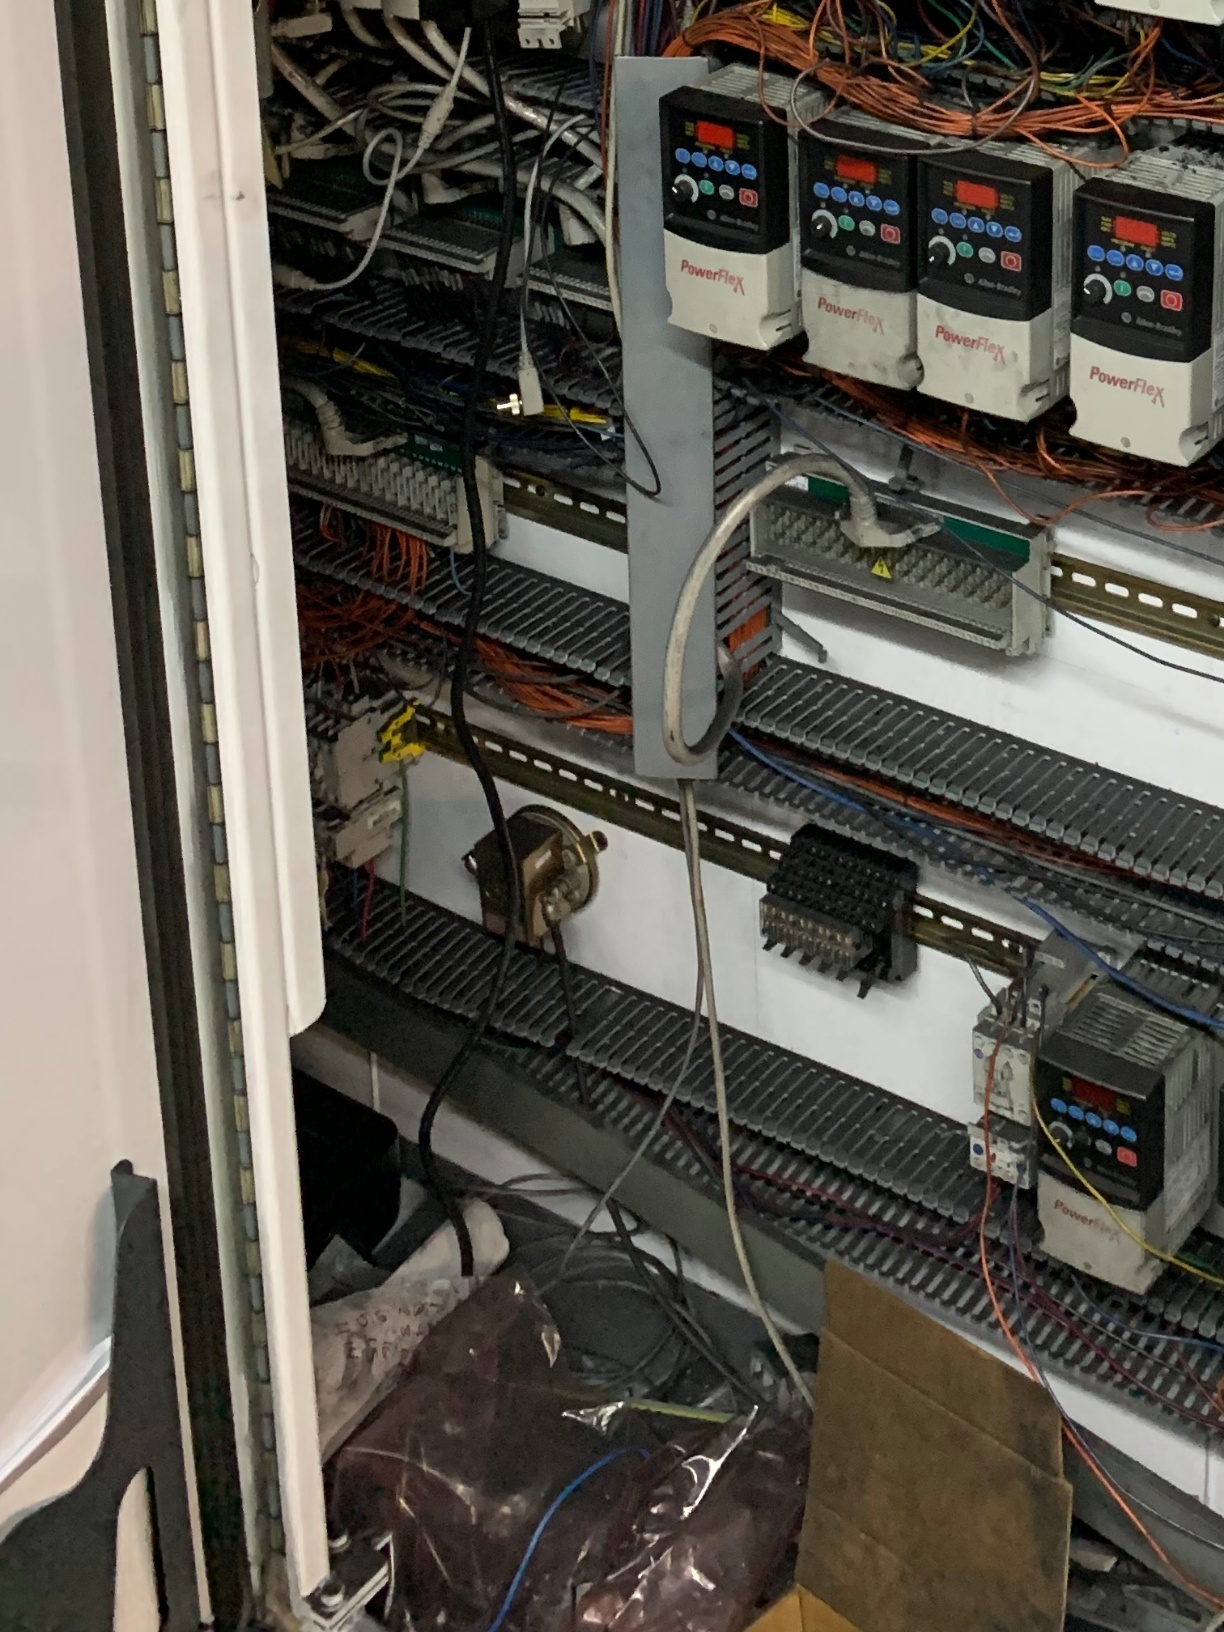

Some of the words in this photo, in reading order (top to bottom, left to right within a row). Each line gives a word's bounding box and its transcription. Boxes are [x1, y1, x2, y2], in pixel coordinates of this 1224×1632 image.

[681, 259, 745, 296] PowerFlex
[935, 325, 1006, 367] PowerFlex
[1089, 365, 1165, 409] PowerFlex
